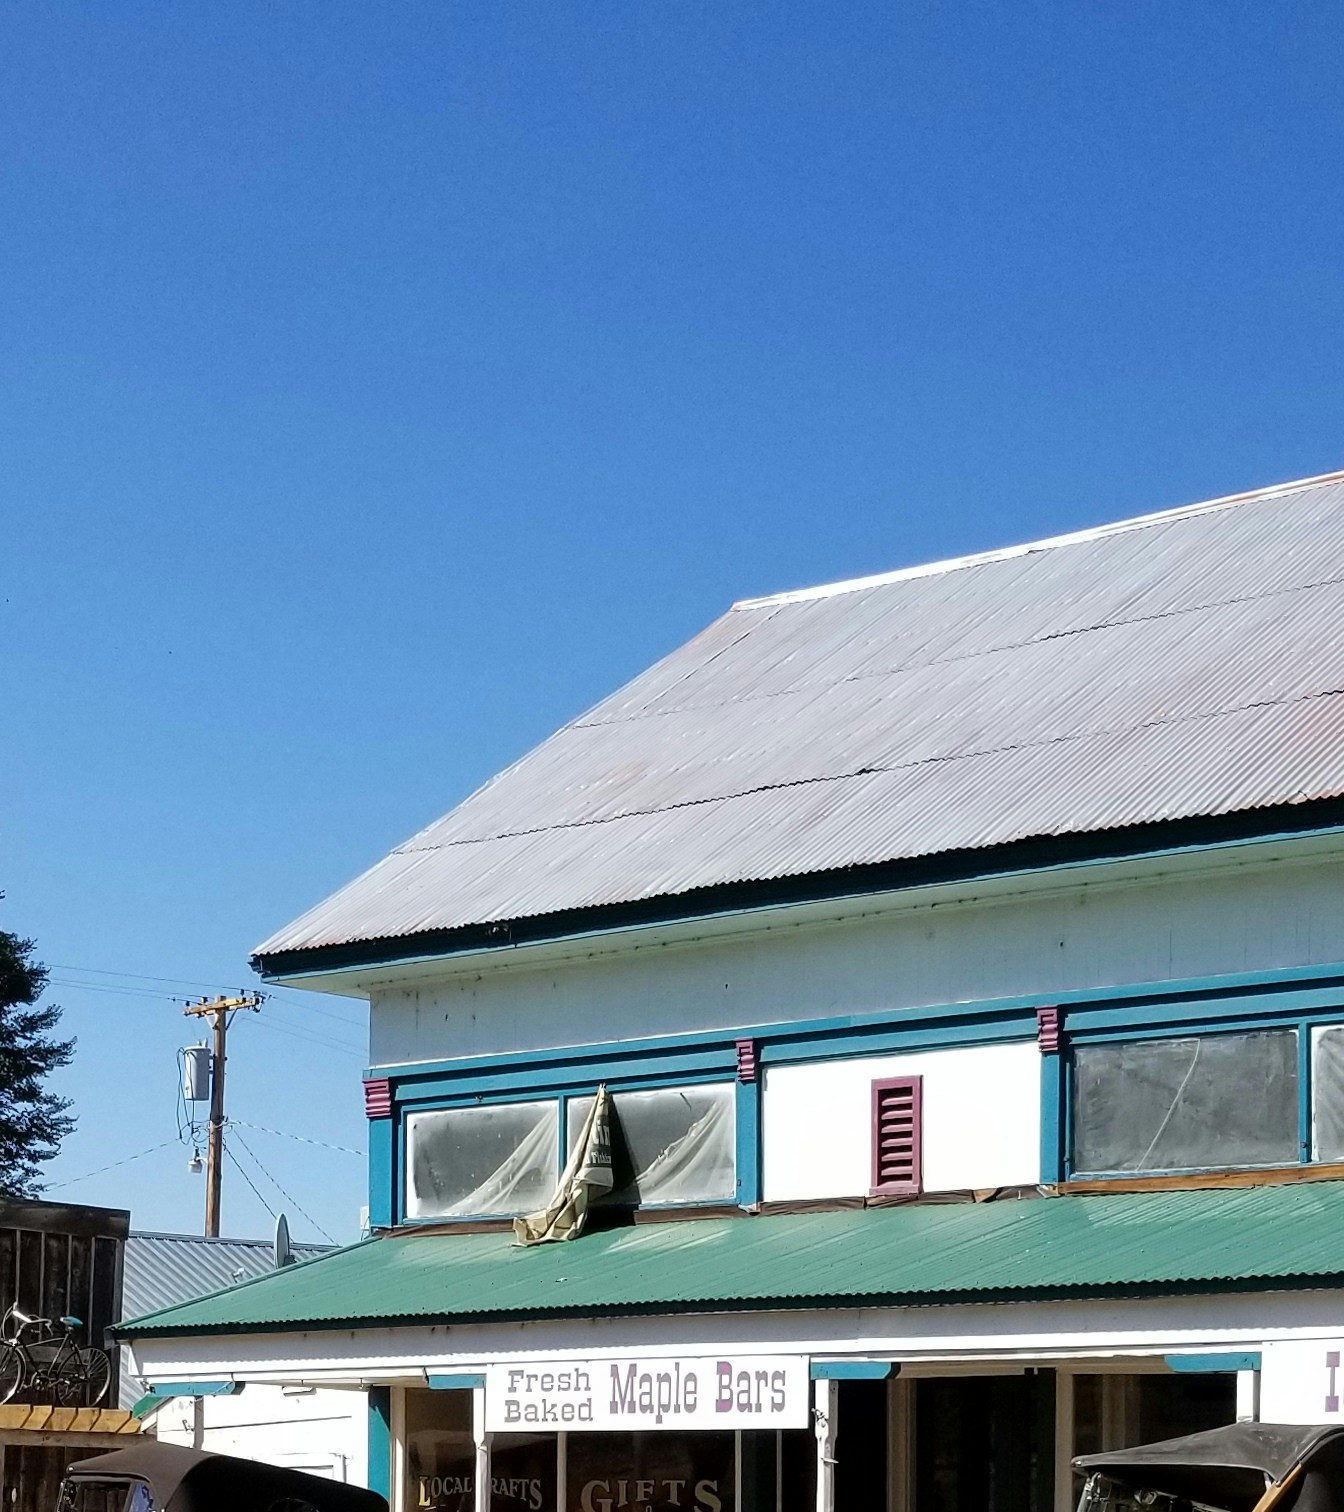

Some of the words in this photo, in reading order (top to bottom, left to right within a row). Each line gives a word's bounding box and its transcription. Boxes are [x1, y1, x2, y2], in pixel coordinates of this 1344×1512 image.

[507, 1368, 591, 1393] Fresh
[609, 1361, 697, 1424] Maple
[715, 1361, 786, 1413] Bars
[504, 1398, 593, 1423] Baked
[418, 1476, 473, 1506] LOCAL
[490, 1477, 543, 1510] RAFTS
